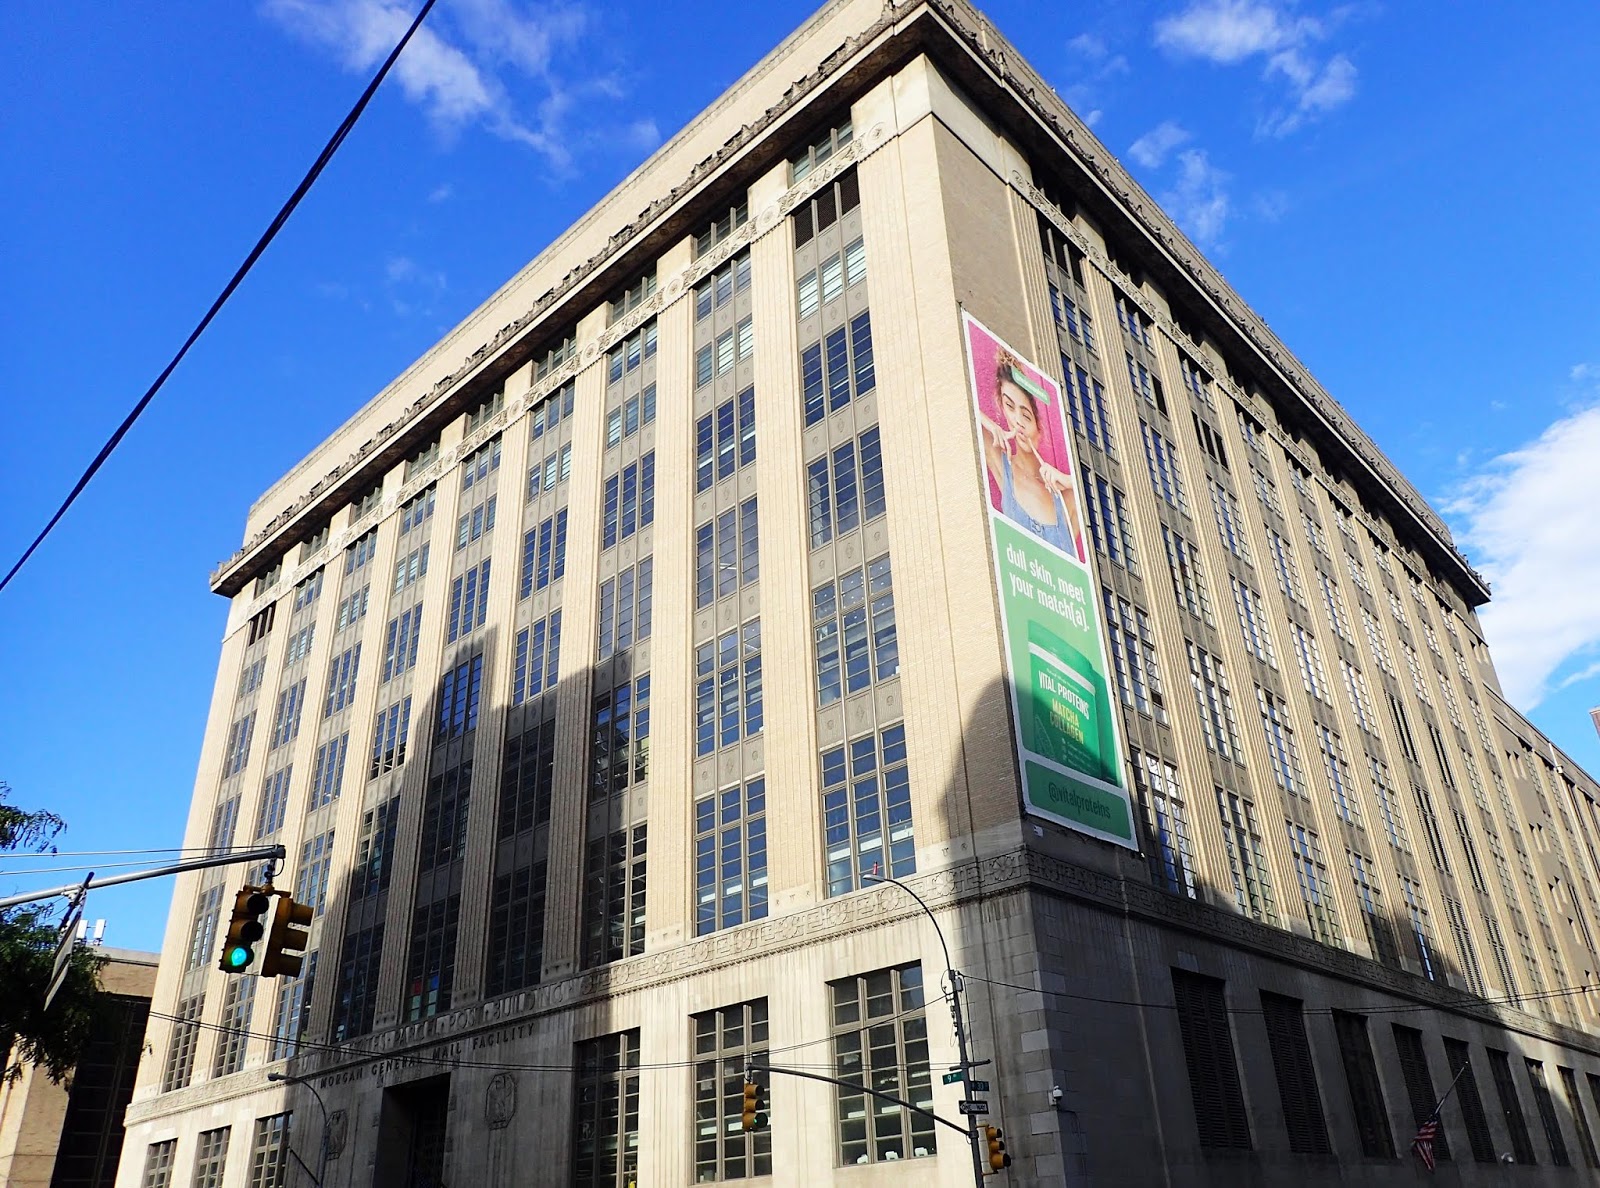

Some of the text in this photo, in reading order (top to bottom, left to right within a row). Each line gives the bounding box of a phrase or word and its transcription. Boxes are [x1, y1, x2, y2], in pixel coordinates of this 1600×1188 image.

[1006, 542, 1087, 606] dull skin, meet
[1008, 571, 1034, 599] your
[1038, 669, 1057, 693] VITAL
[1057, 682, 1090, 720] PROTEINS
[1052, 697, 1080, 728] MATCHA
[1049, 711, 1084, 745] COLLAGEN
[1048, 781, 1111, 819] @vitalproteins
[320, 1066, 364, 1089] MORGAN
[433, 1042, 462, 1060] MAIL
[472, 1022, 535, 1050] FACILITY
